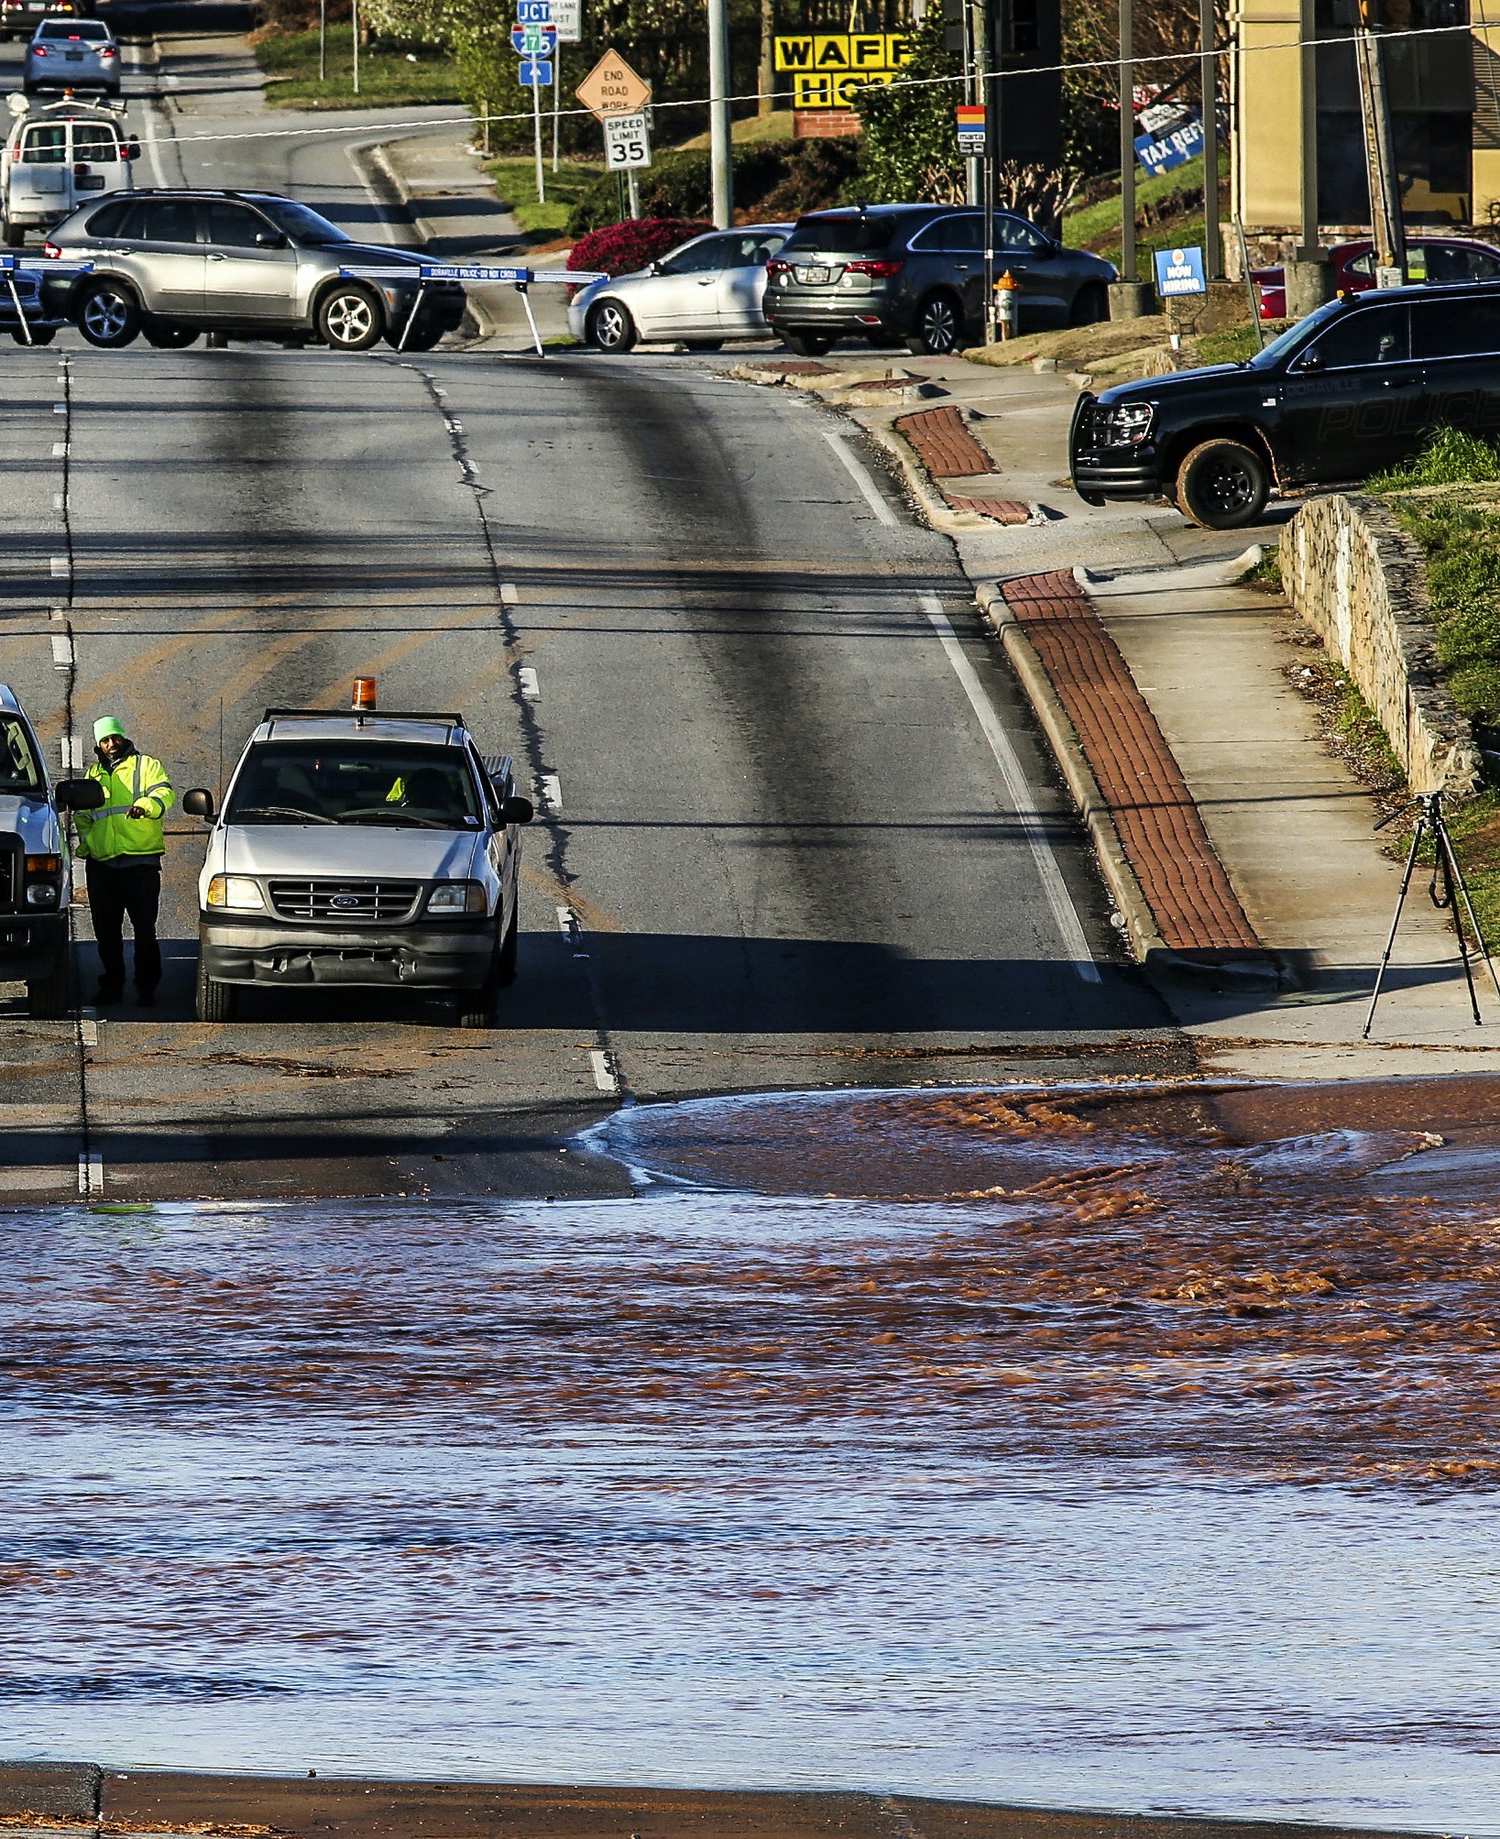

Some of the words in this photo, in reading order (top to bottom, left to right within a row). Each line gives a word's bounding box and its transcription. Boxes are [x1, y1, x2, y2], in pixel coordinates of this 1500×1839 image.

[520, 4, 548, 20] JCT
[520, 36, 551, 54] 25
[529, 37, 538, 49] 7
[780, 39, 911, 66] WAFF
[604, 71, 623, 81] END
[601, 86, 628, 96] ROAD
[602, 101, 629, 111] WORK
[608, 119, 643, 130] SPEED
[612, 131, 640, 141] LIMIT
[960, 133, 984, 141] marta
[1140, 139, 1173, 166] TAX
[1170, 119, 1204, 150] REF
[612, 141, 644, 162] 35
[1166, 264, 1192, 279] NOW
[1162, 277, 1201, 293] HIRING
[1286, 378, 1362, 397] DORAVILLE
[1317, 388, 1500, 442] POLICE
